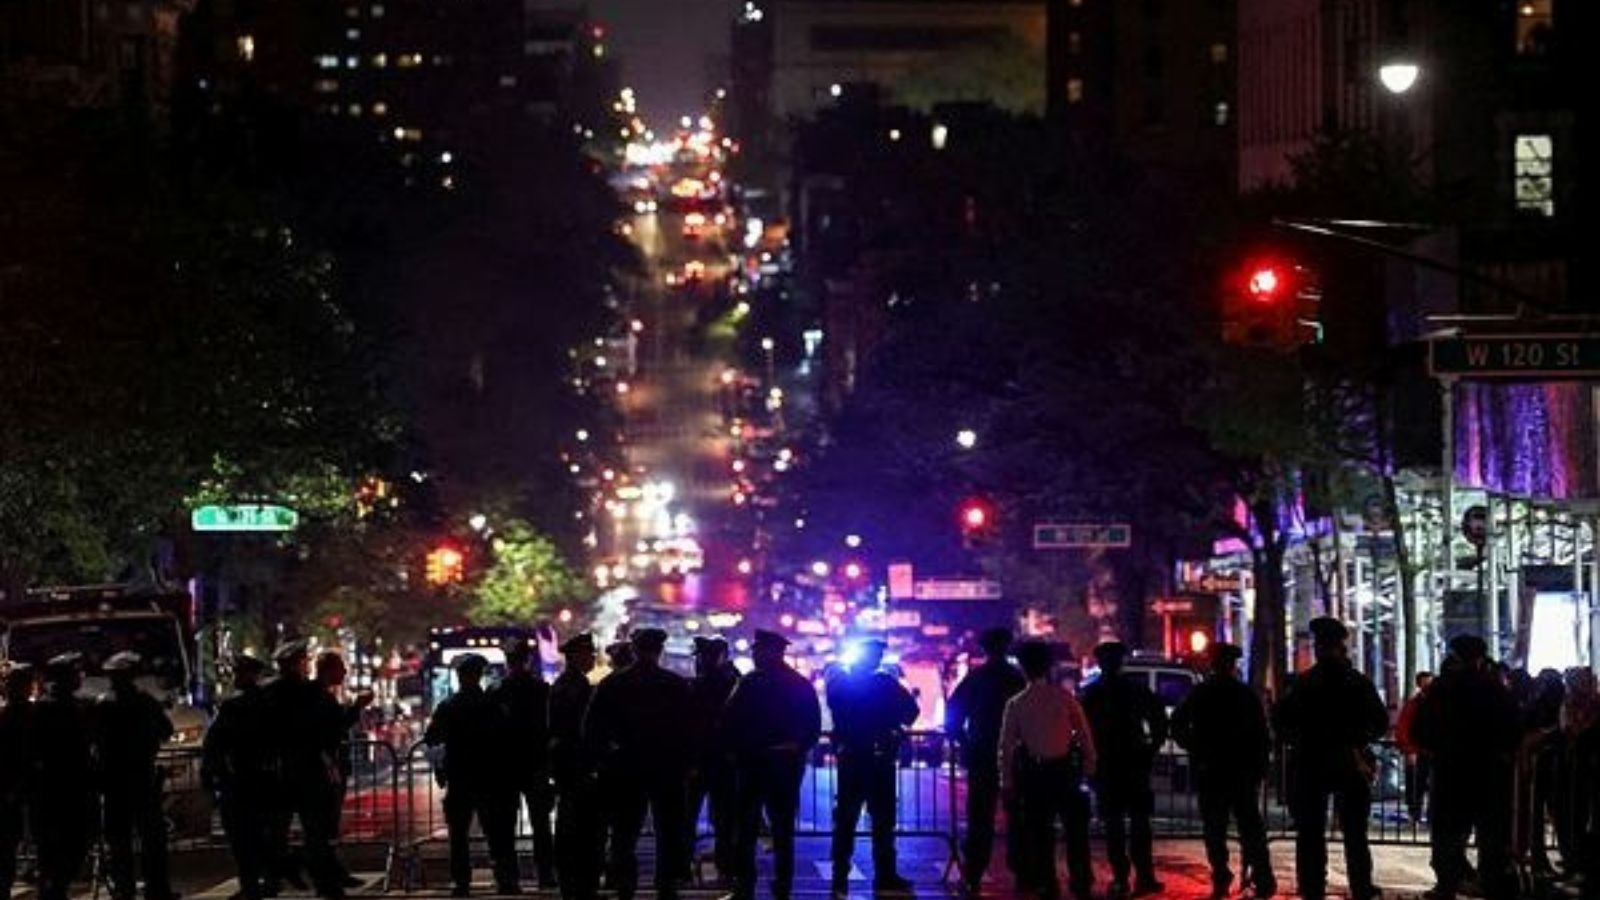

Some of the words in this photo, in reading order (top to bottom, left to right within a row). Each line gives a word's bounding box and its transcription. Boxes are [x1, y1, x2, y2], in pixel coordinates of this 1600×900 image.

[1467, 342, 1490, 366] W
[1502, 342, 1544, 366] 120
[1556, 342, 1581, 366] St
